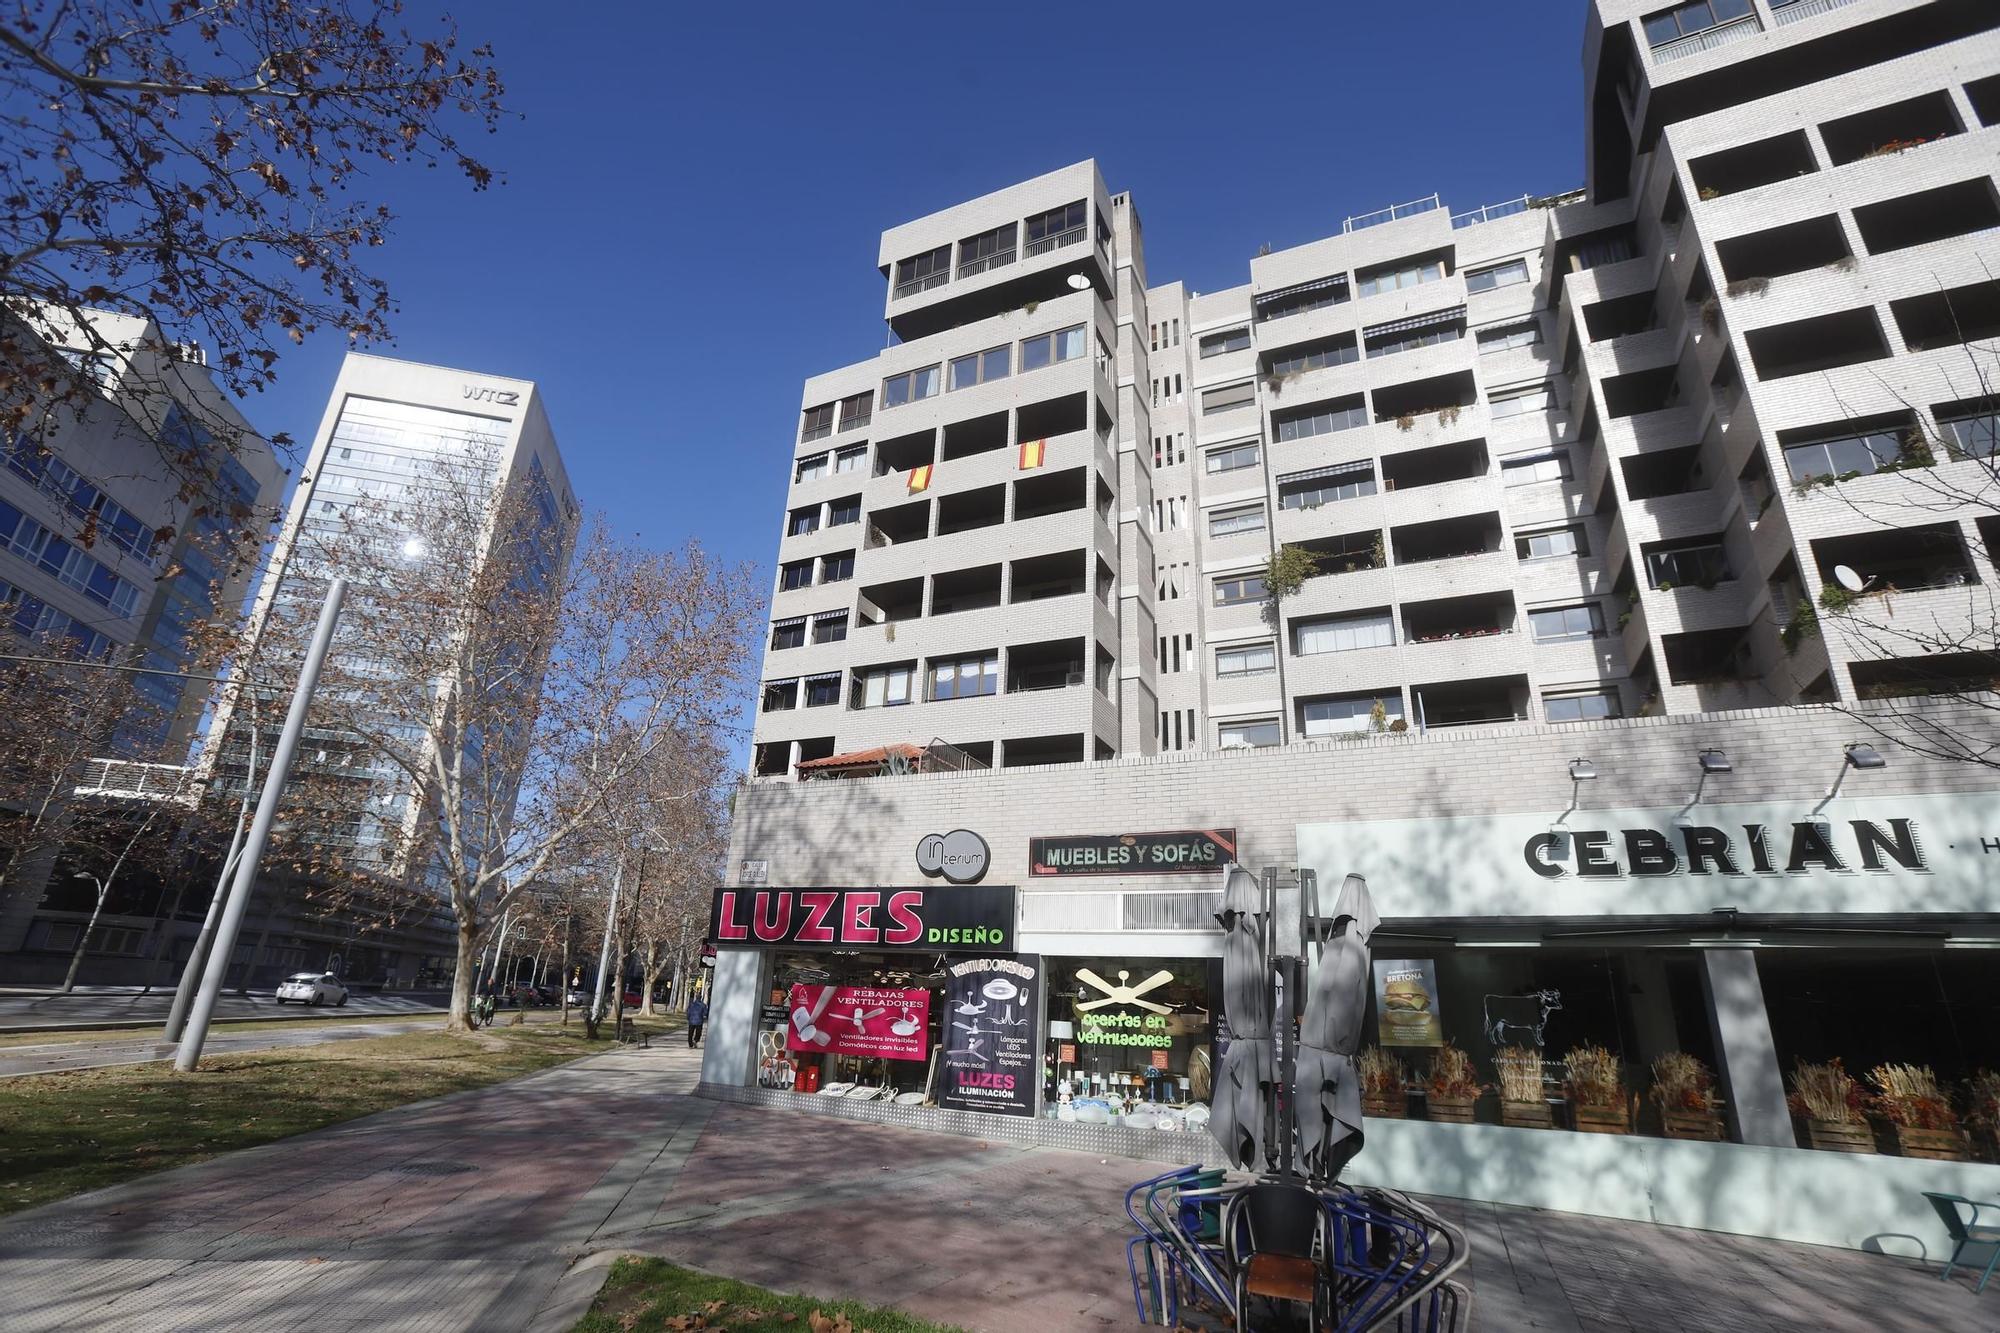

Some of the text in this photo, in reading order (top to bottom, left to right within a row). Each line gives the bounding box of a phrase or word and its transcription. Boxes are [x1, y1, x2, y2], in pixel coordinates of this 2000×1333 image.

[928, 838, 984, 865] interium
[1047, 838, 1216, 866] MUEBLES Y SOFÁS
[1524, 818, 1930, 878] CEBRIAN
[718, 891, 923, 944] LUZES
[928, 925, 1004, 945] DISEÑO
[950, 958, 1018, 978] VENTILADORES
[837, 997, 924, 1008] VENTILADORES
[853, 990, 904, 999] REBAJAS
[840, 1032, 883, 1042] Ventiladores
[839, 1041, 877, 1050] Domóticos
[906, 1045, 918, 1053] led
[995, 1050, 1031, 1059] Ventiladores
[959, 1071, 1015, 1089] LUZES
[959, 1086, 1014, 1098] ILUMINACIÓN
